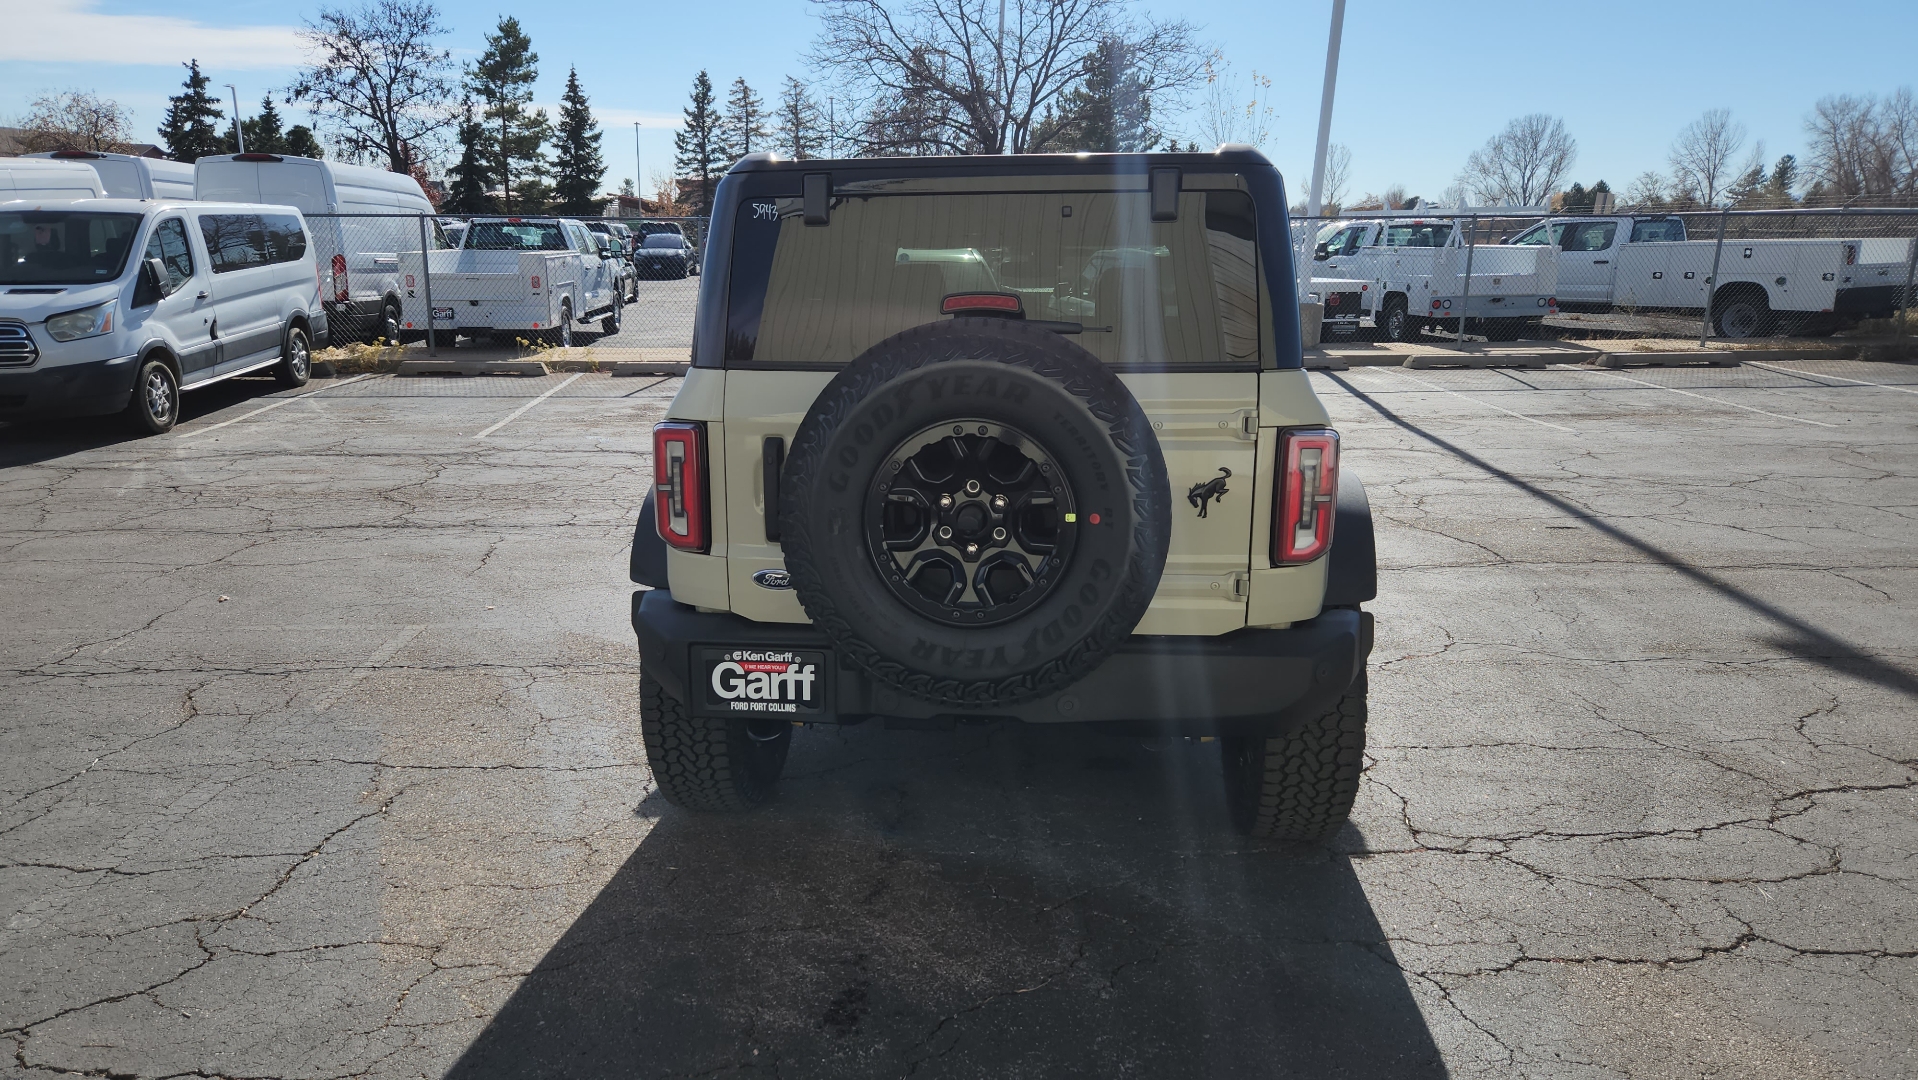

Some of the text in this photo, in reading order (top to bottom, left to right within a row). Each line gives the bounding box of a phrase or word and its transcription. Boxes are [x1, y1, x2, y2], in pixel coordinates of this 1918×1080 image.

[752, 203, 778, 221] 5943
[763, 573, 790, 586] Ford
[743, 651, 792, 662] Ken Garff
[712, 661, 815, 700] Garff
[731, 702, 796, 713] FORD FORT COLLINS
